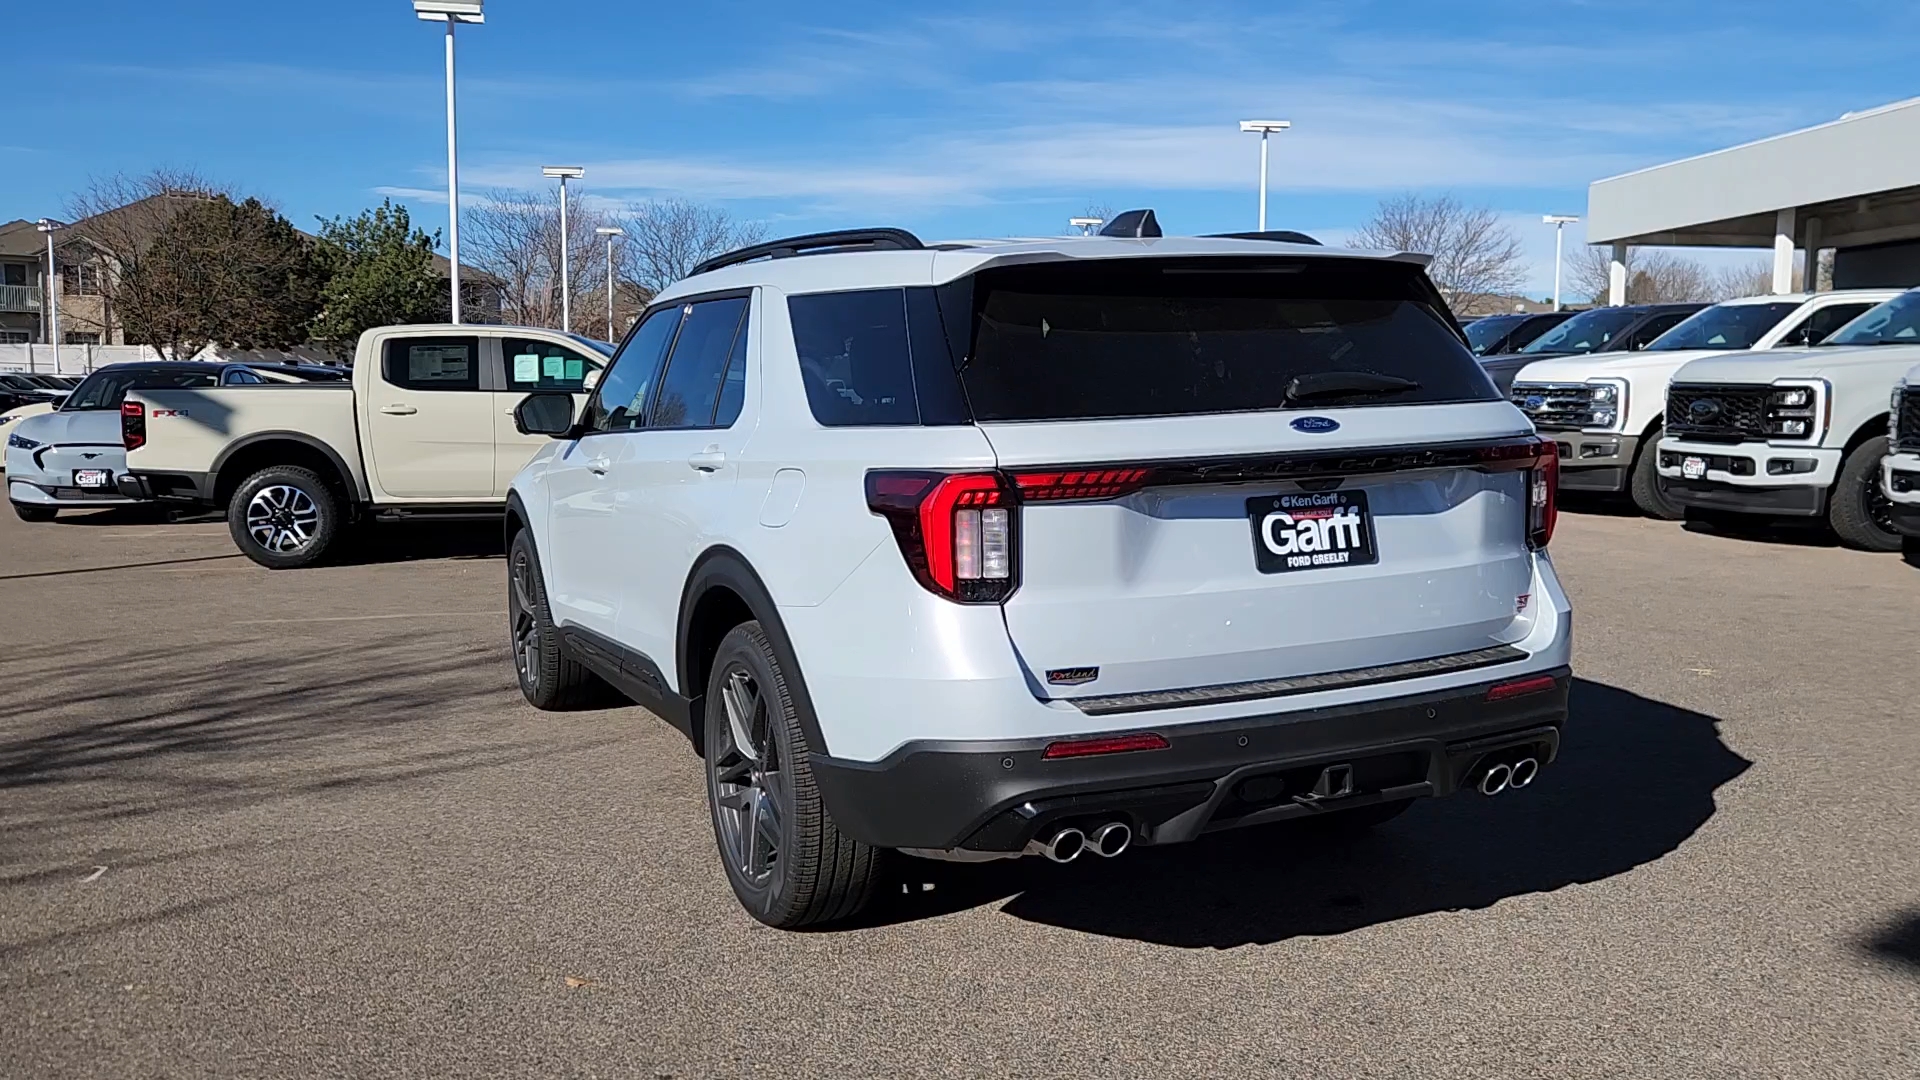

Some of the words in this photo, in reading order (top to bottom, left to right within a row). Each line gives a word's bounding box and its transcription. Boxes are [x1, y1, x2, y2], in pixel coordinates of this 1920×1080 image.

[153, 410, 189, 418] FX4
[75, 471, 107, 485] Garff
[1291, 495, 1312, 507] Ken
[1312, 493, 1338, 506] Garff
[1262, 506, 1361, 555] Garff
[1288, 555, 1311, 567] FORD
[1312, 552, 1349, 565] GREELEY
